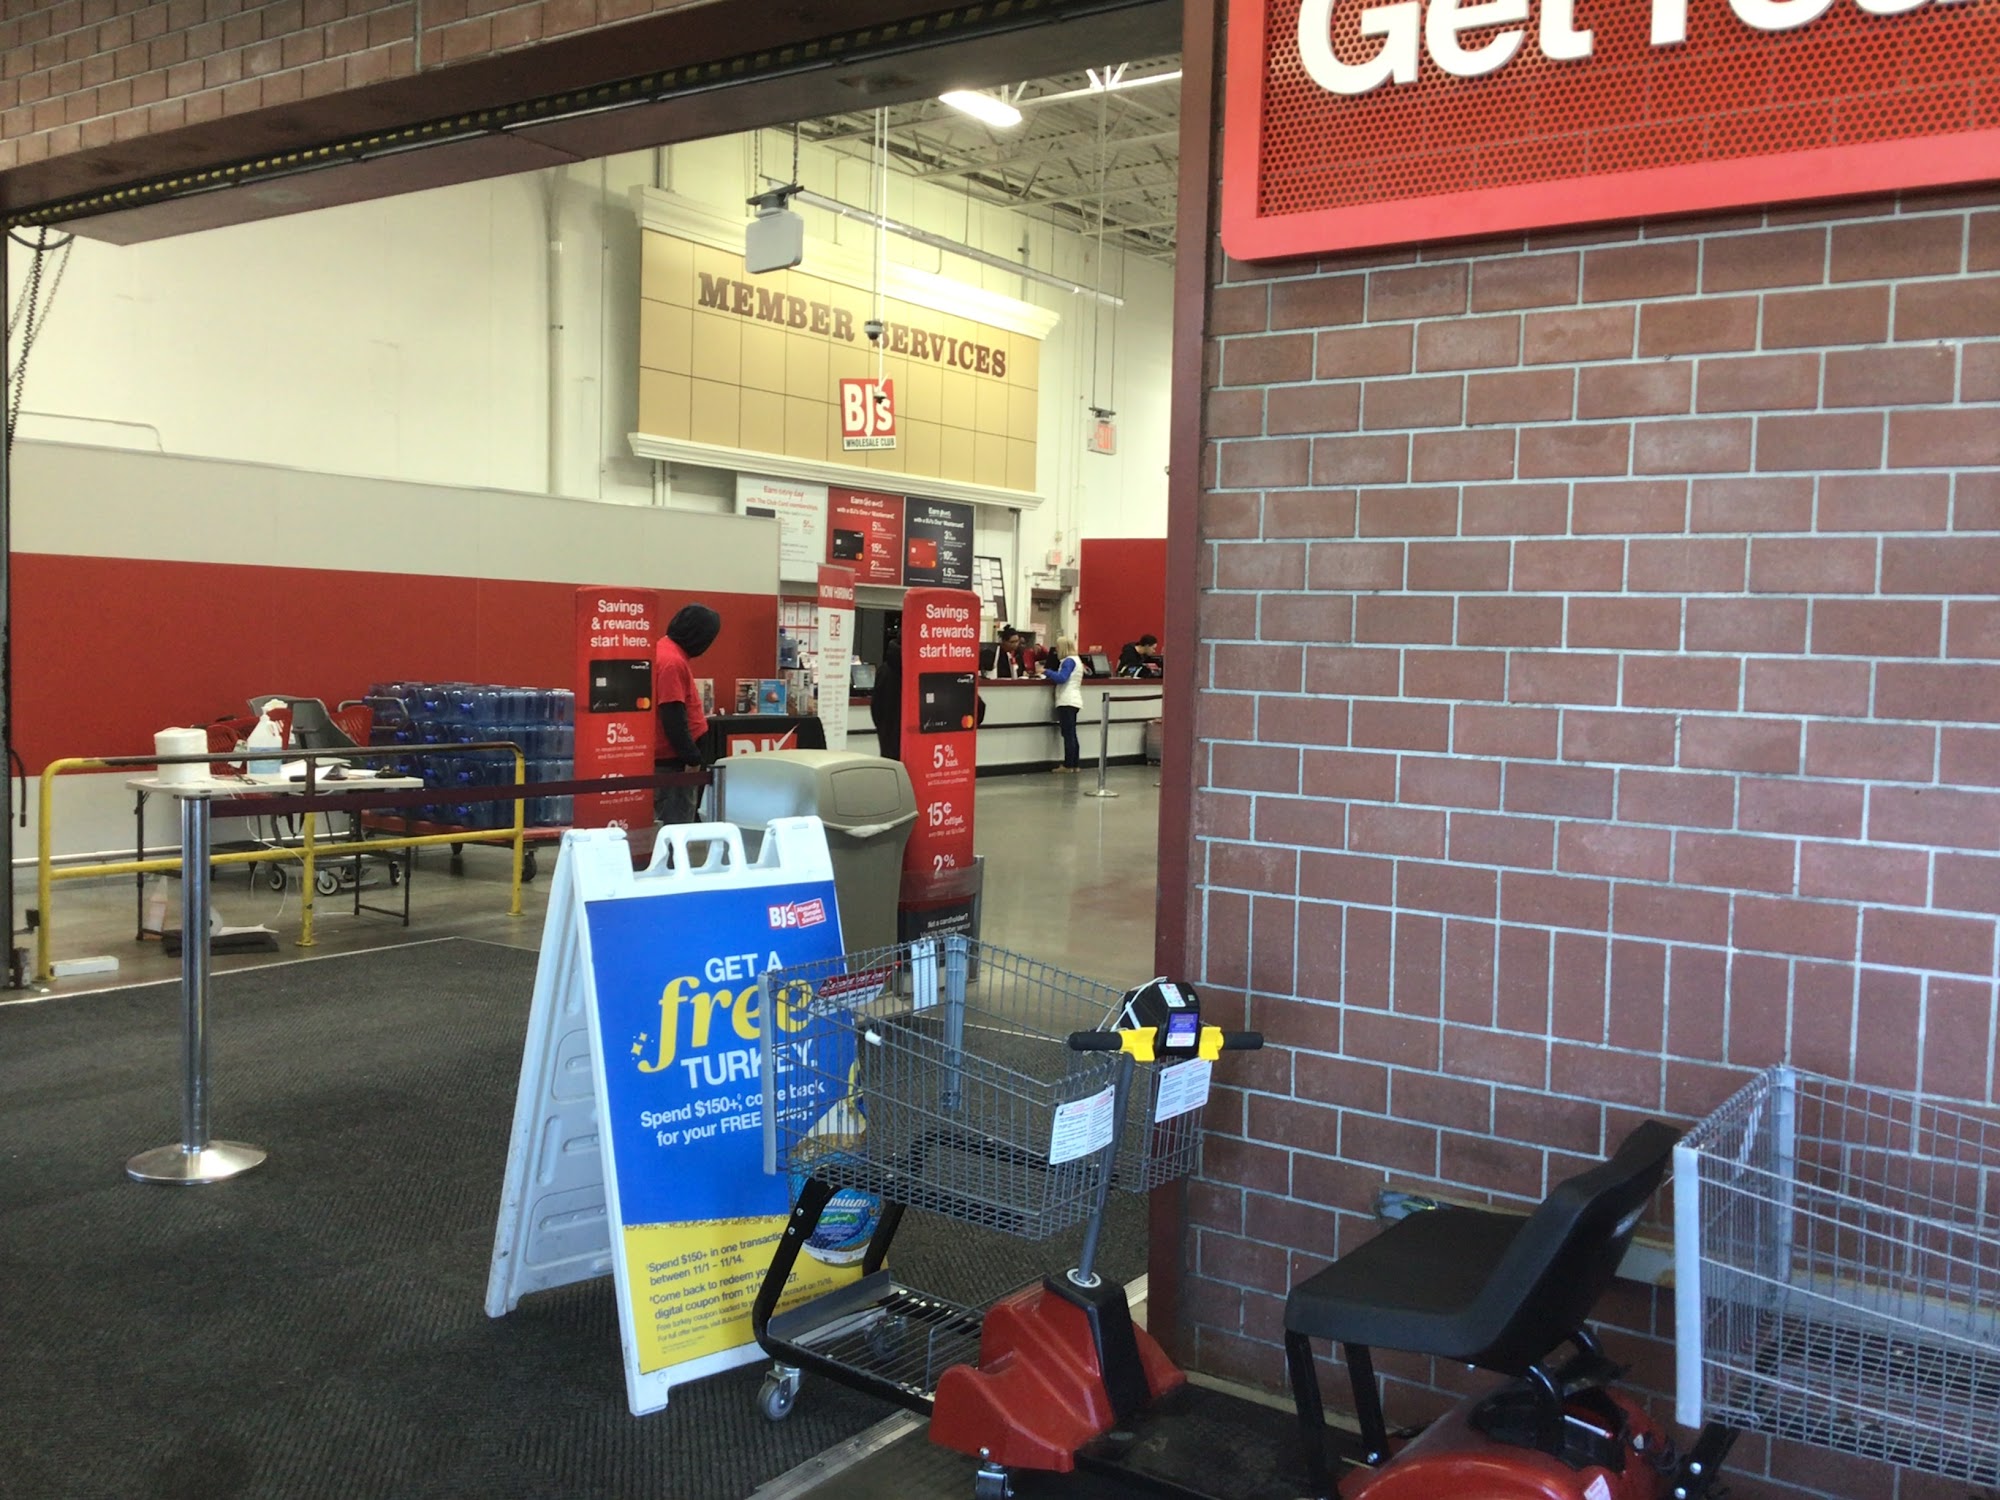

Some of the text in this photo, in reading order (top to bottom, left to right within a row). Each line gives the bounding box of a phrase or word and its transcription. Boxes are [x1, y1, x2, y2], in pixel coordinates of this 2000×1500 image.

[698, 272, 1006, 378] MEMBER SERVICES
[881, 438, 895, 447] CLUB
[820, 585, 853, 600] NOW HIRING
[598, 599, 644, 616] Savings
[926, 604, 969, 622] Savings
[591, 617, 650, 631] & rewards
[920, 623, 974, 638] & rewards
[590, 634, 651, 647] start here.
[919, 643, 974, 658] start here.
[606, 722, 628, 744] 5%
[617, 735, 635, 743] back
[933, 744, 954, 768] 5%
[933, 854, 955, 879] 2%
[705, 951, 783, 983] GET A
[637, 976, 813, 1073] free
[640, 1103, 692, 1129] Spend
[745, 1088, 786, 1107] coe
[656, 1131, 679, 1147] for
[682, 1123, 717, 1145] your
[721, 1111, 762, 1134] FREE
[826, 1194, 870, 1207] mium
[648, 1232, 783, 1273] Spend $150+ in one transactio
[650, 1269, 690, 1286] between
[693, 1262, 710, 1274] 11/1
[683, 1284, 706, 1296] back
[708, 1281, 717, 1290] to
[720, 1271, 753, 1287] redeem
[655, 1303, 683, 1319] digital
[685, 1295, 720, 1310] coupon
[722, 1288, 743, 1300] from
[656, 1323, 671, 1332] Free
[672, 1317, 692, 1328] turkey
[693, 1310, 718, 1322] coupon
[719, 1303, 740, 1314] loaded
[783, 1285, 807, 1296] account
